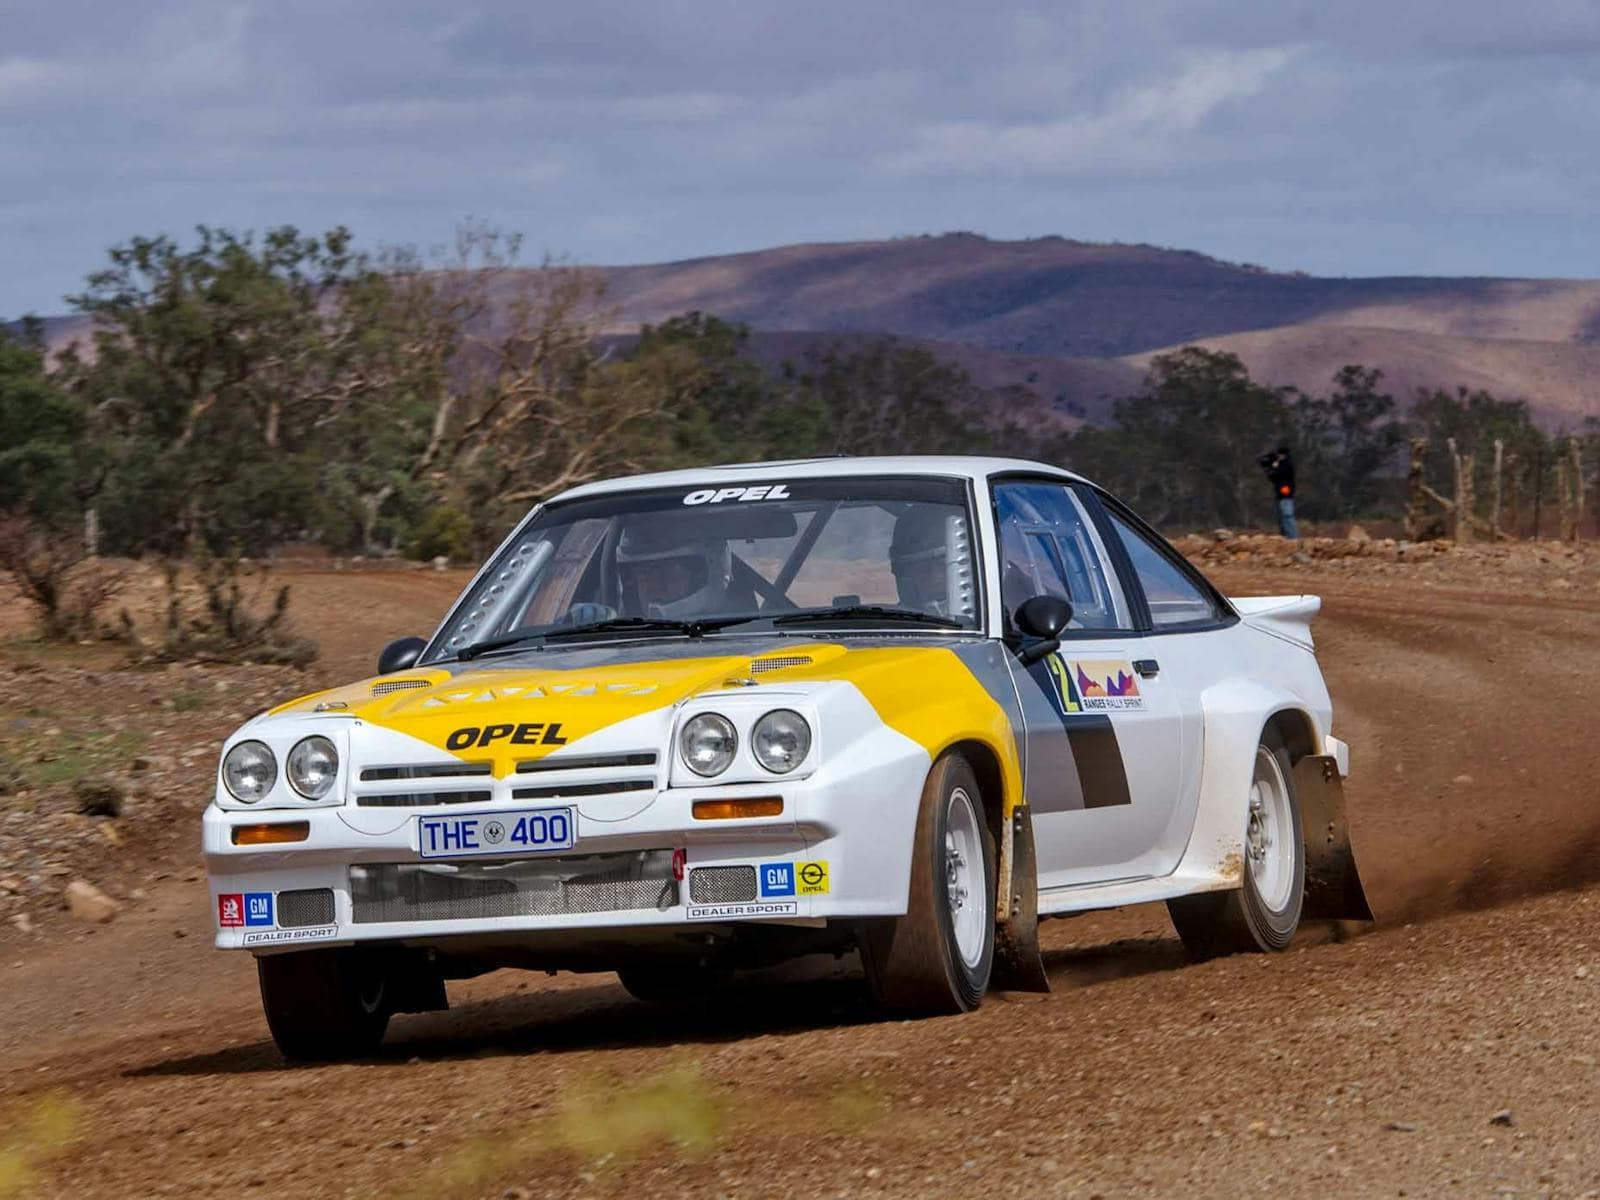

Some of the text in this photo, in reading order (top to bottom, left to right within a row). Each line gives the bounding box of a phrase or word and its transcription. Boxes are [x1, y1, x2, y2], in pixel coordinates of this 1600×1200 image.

[683, 485, 791, 505] OPEL
[1047, 653, 1080, 712] 2
[446, 723, 568, 750] OPEL
[424, 815, 567, 851] THE 400
[766, 869, 788, 885] GM
[802, 885, 824, 893] OPEL
[250, 898, 268, 914] GM
[691, 904, 792, 917] DEALER SPORT
[247, 928, 334, 942] DEALER SPORT
